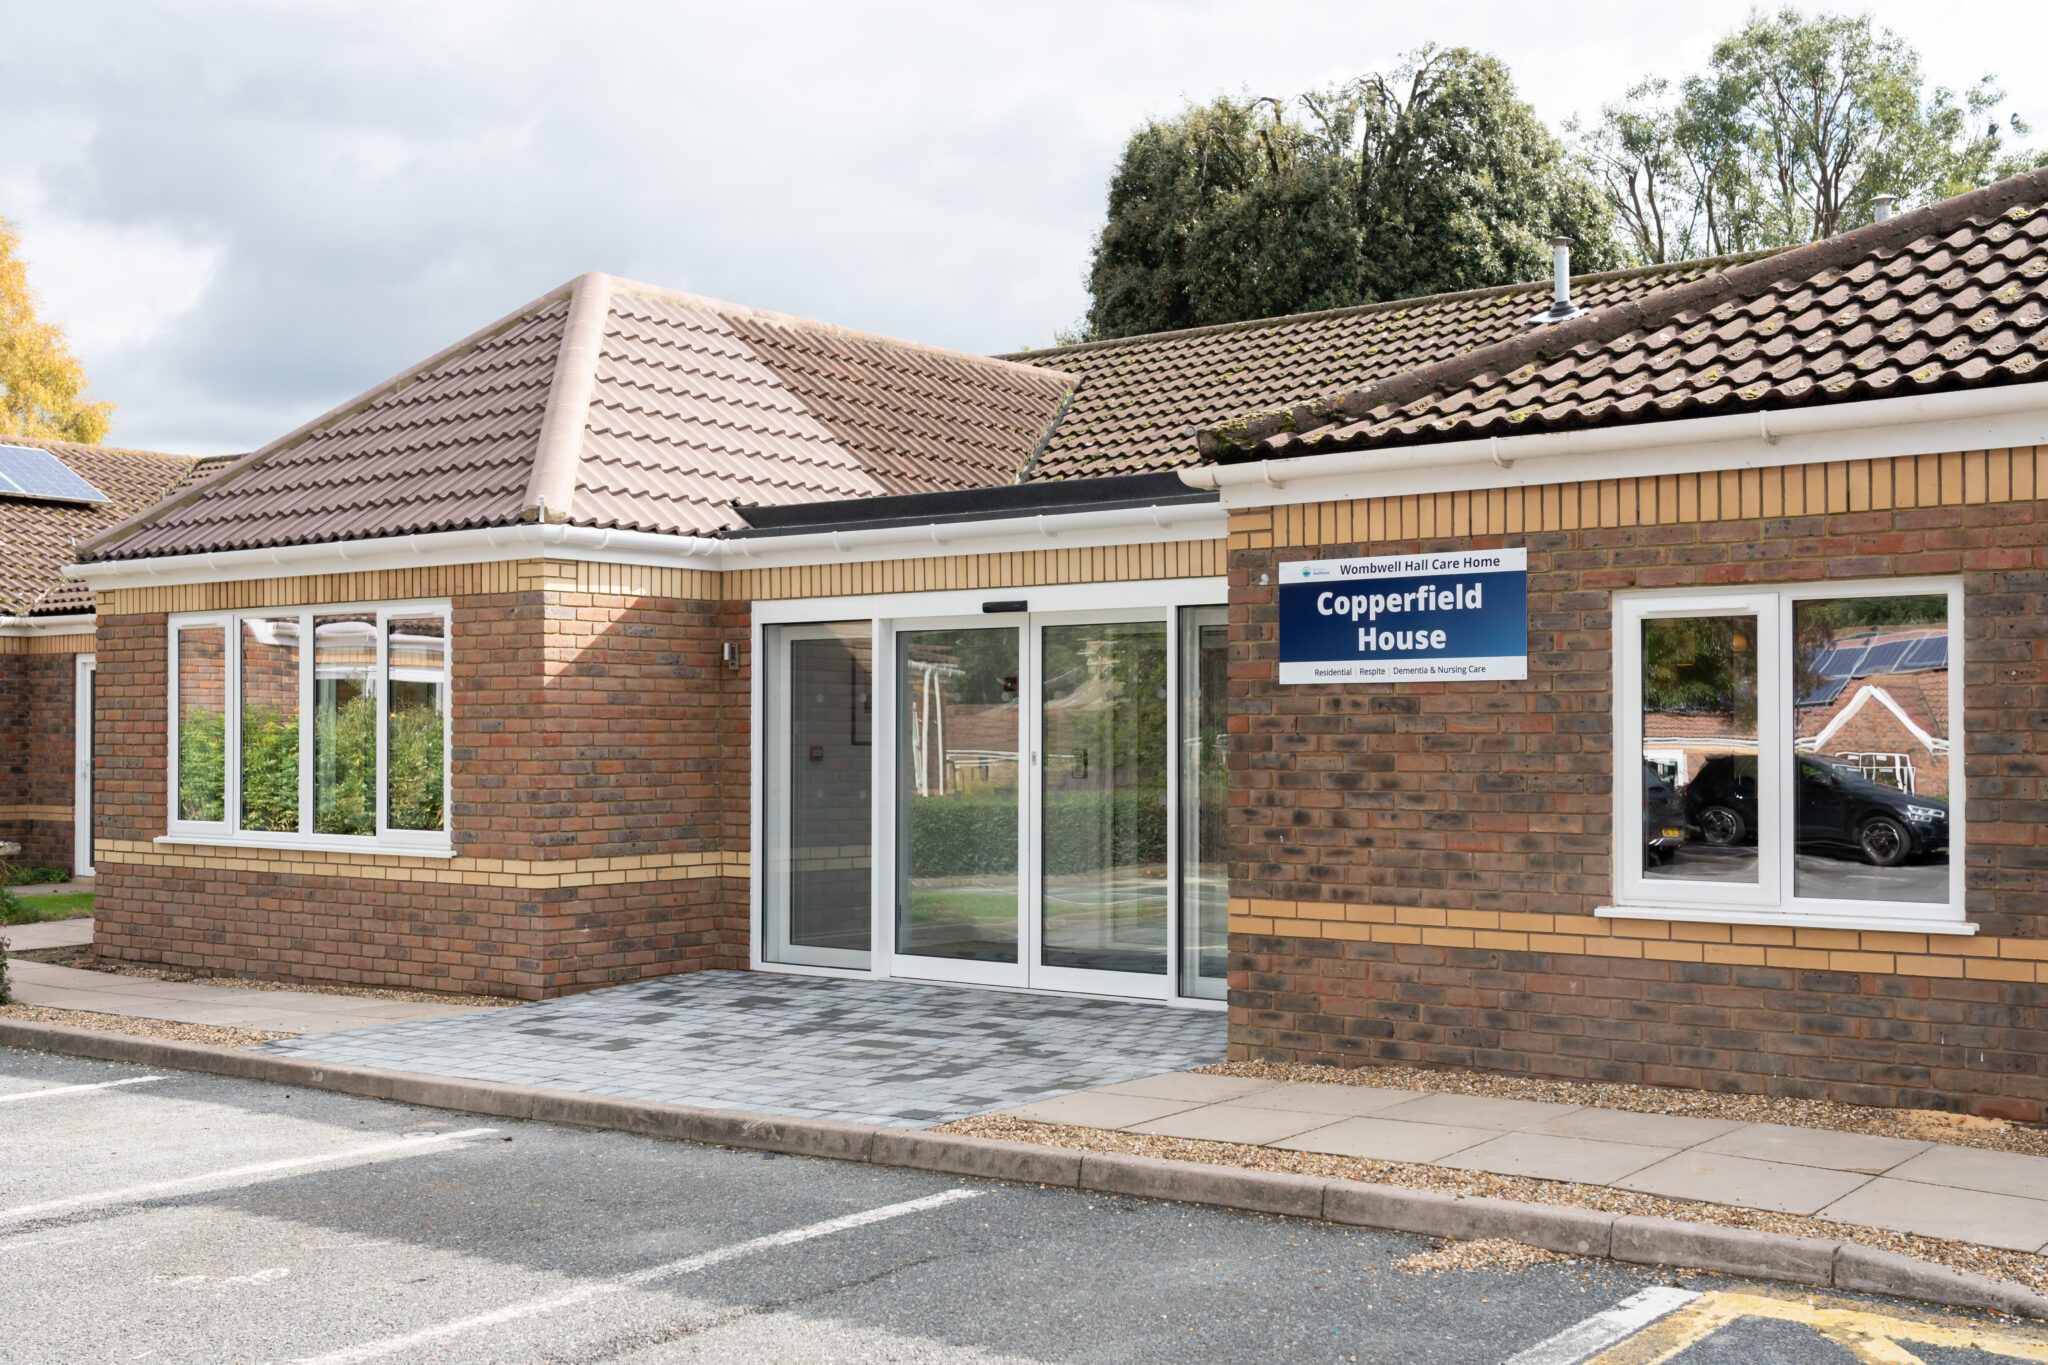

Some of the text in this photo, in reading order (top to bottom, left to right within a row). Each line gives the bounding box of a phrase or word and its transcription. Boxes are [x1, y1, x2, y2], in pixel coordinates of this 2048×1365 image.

[1340, 561, 1401, 575] Wombwell
[1405, 559, 1428, 571] Hall
[1432, 559, 1460, 570] Care
[1463, 557, 1501, 568] Home
[1316, 582, 1482, 621] Copperfield
[1358, 627, 1447, 651] House
[1314, 665, 1486, 677] Residential Respite Dementia & Nursing Care
